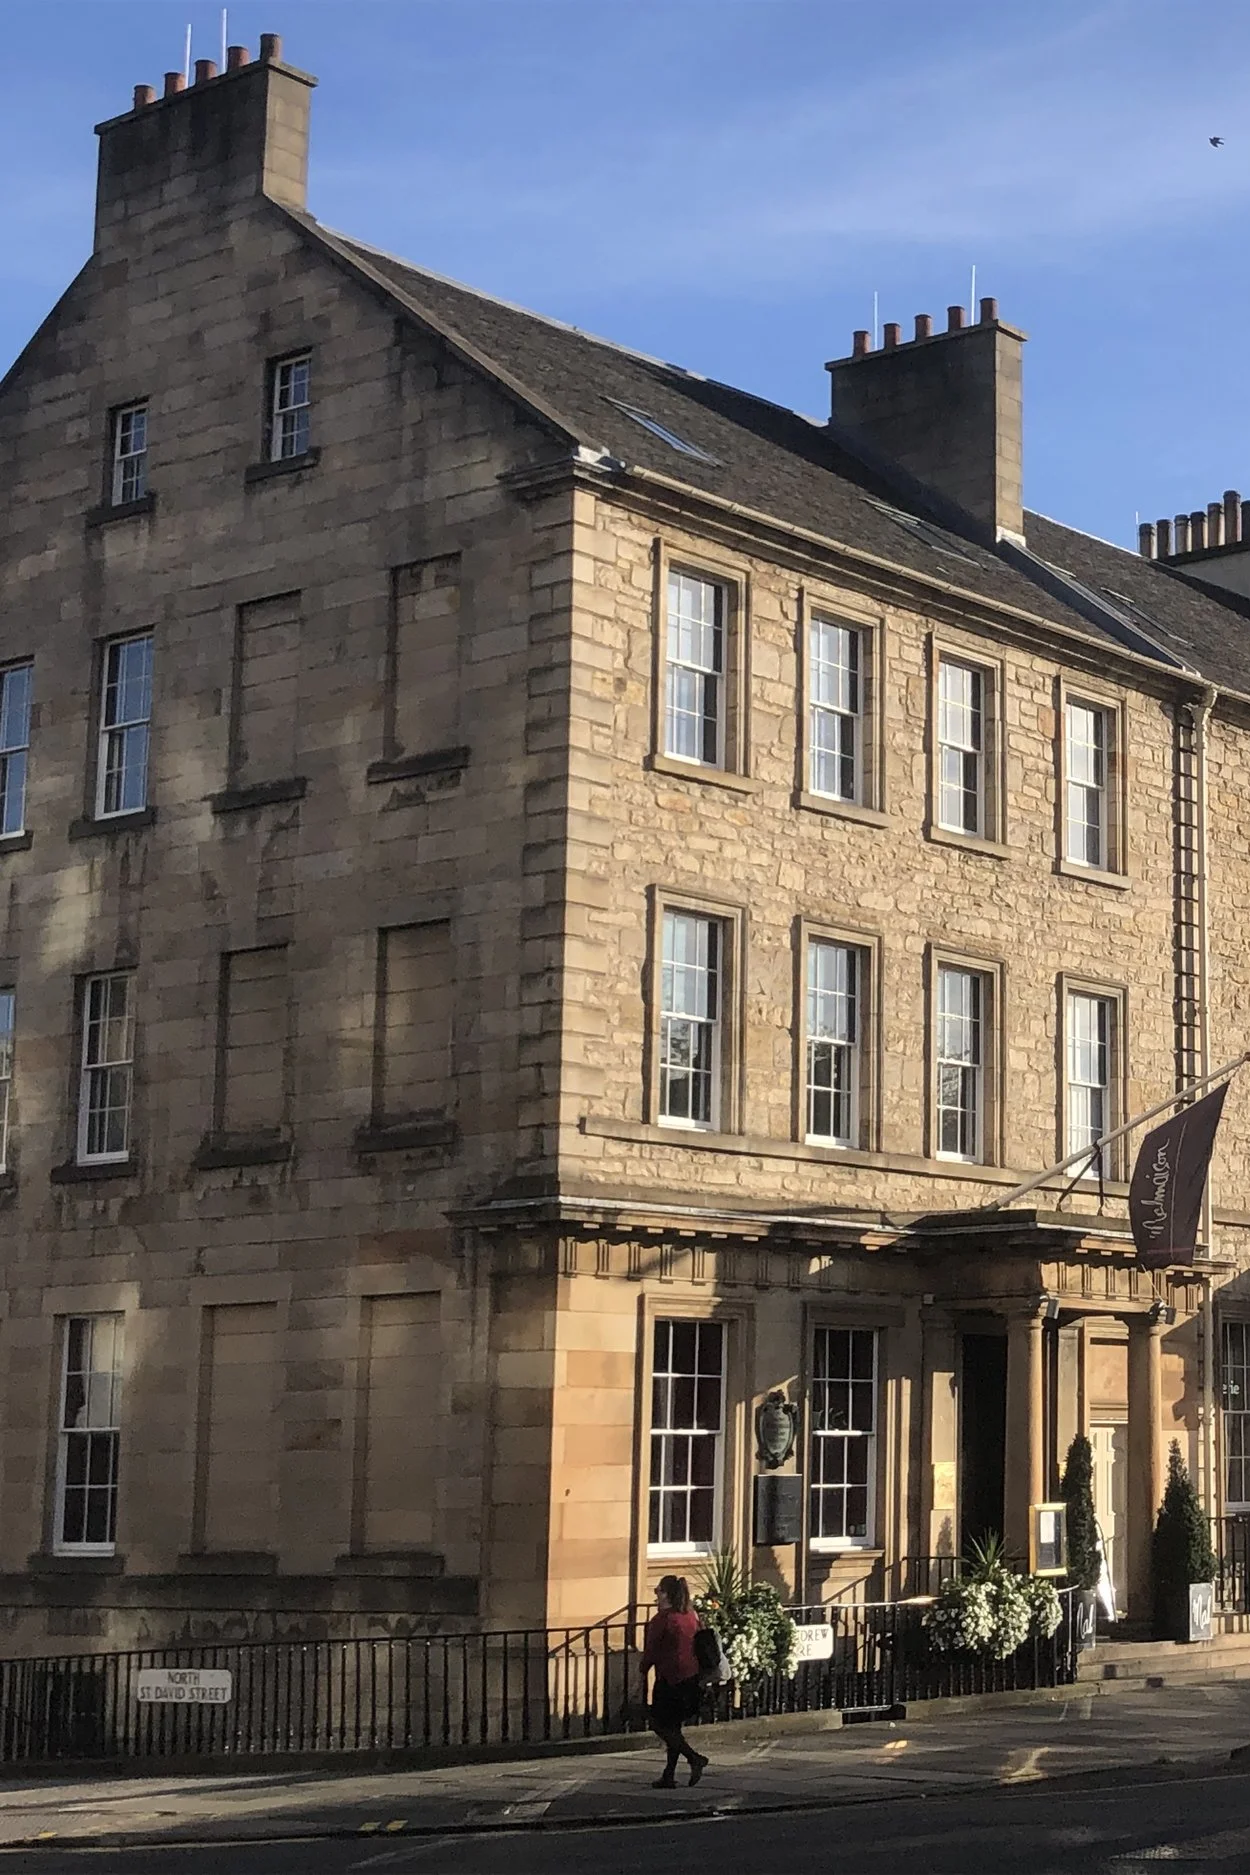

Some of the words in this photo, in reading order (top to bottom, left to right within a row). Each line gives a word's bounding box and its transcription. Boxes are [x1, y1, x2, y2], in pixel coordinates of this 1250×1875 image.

[1141, 1138, 1171, 1239] Malmaison
[800, 1629, 830, 1642] DREW
[167, 1671, 200, 1685] NORTH
[140, 1686, 151, 1699] ST
[155, 1686, 186, 1700] DAVID
[189, 1687, 227, 1700] STREET
